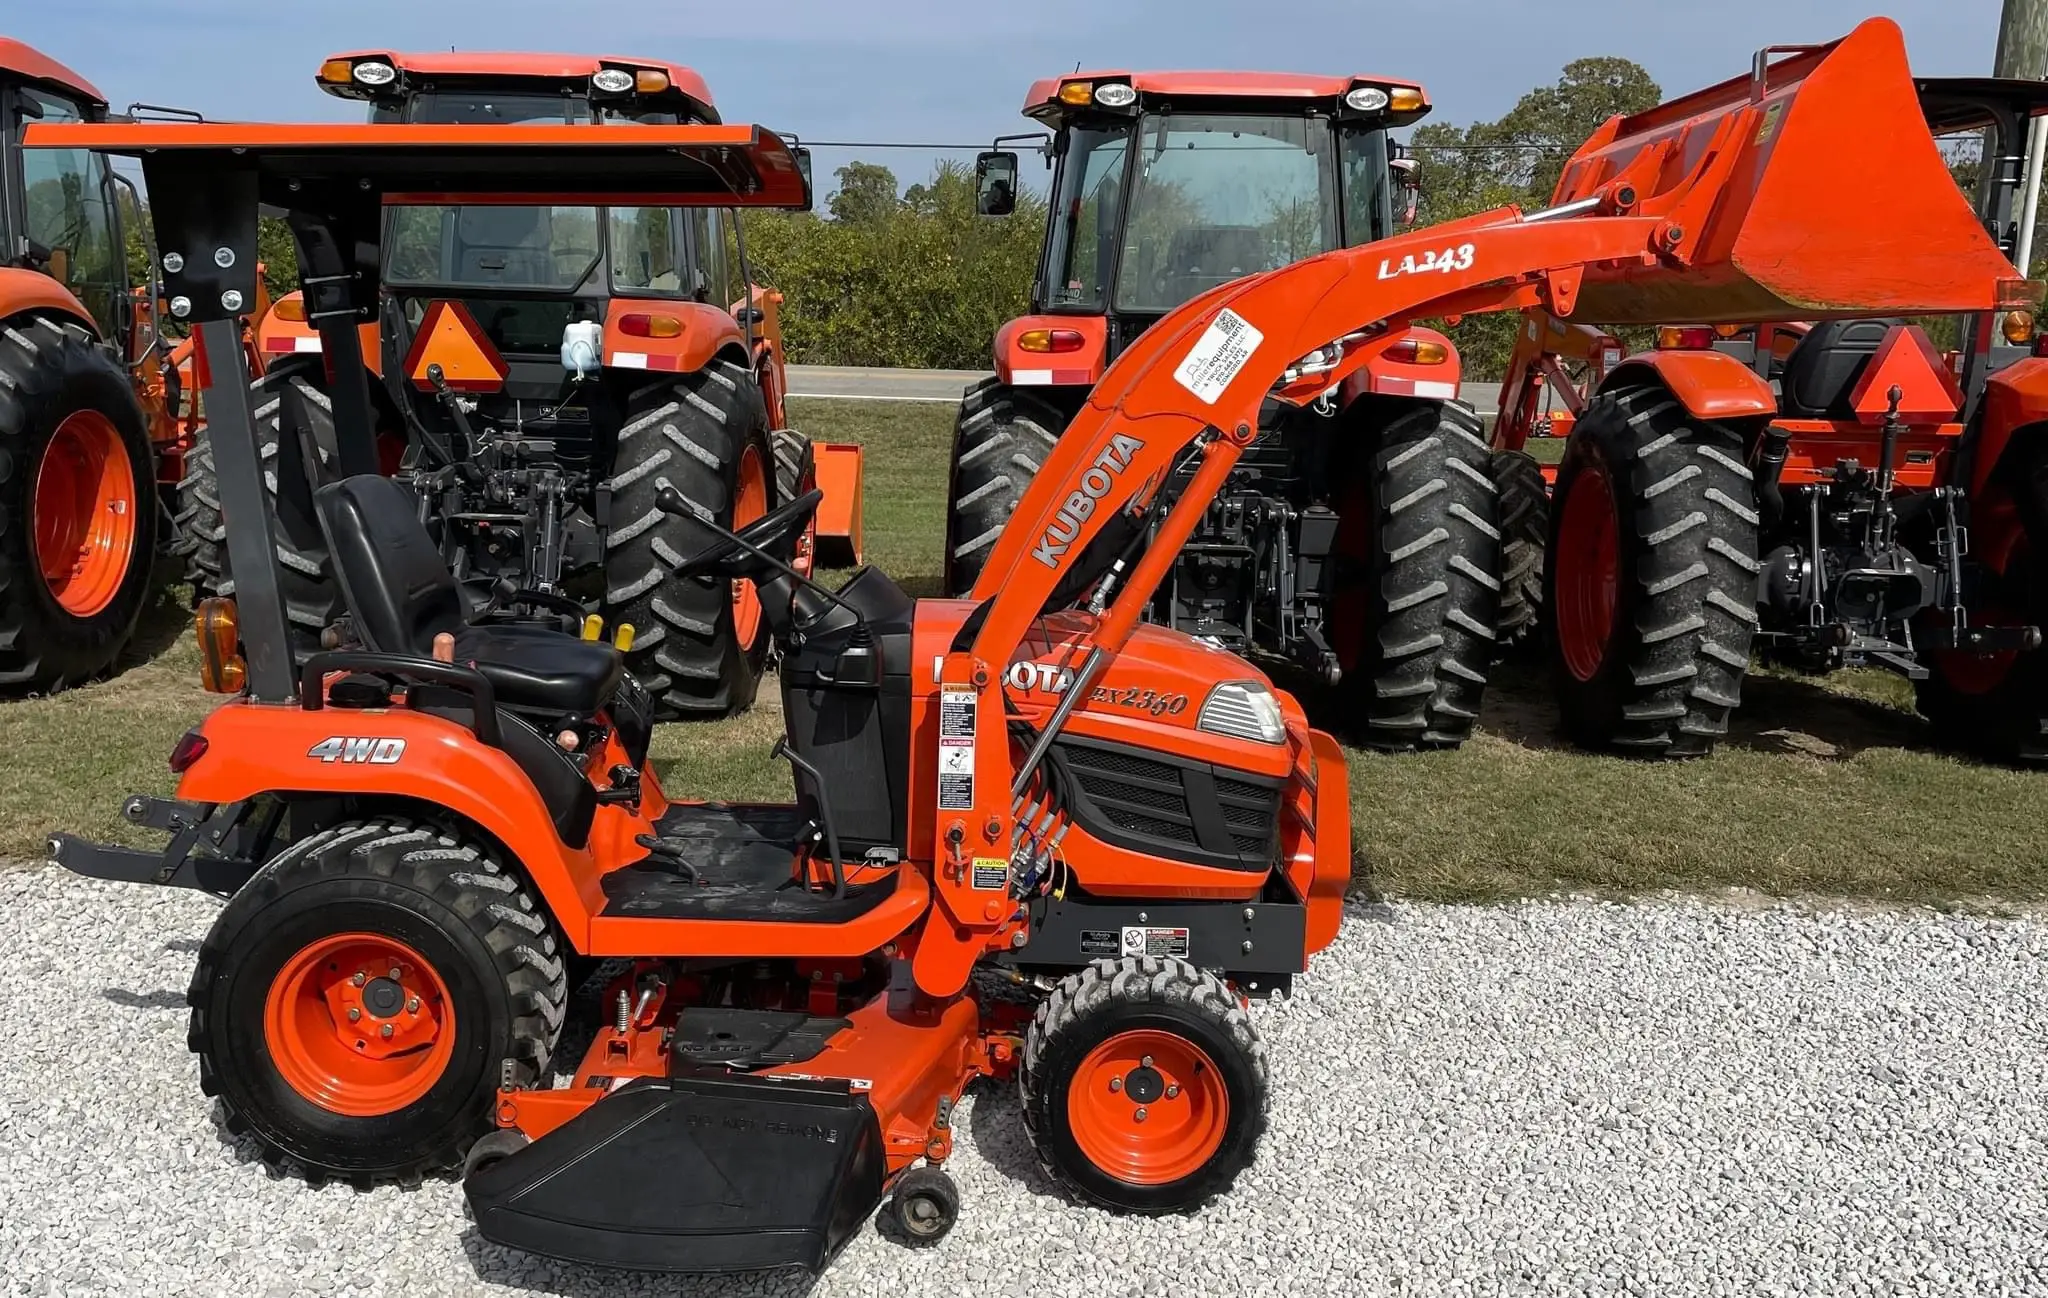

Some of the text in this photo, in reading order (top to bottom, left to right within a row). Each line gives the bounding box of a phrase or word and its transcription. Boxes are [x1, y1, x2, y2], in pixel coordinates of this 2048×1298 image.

[1377, 243, 1475, 280] LA343
[1207, 364, 1222, 381] TRUCK
[1221, 345, 1237, 363] SALES
[1235, 333, 1246, 346] LLC
[1031, 432, 1146, 569] KUBOTA
[1087, 686, 1189, 716] BX2360
[307, 736, 407, 764] 4WD
